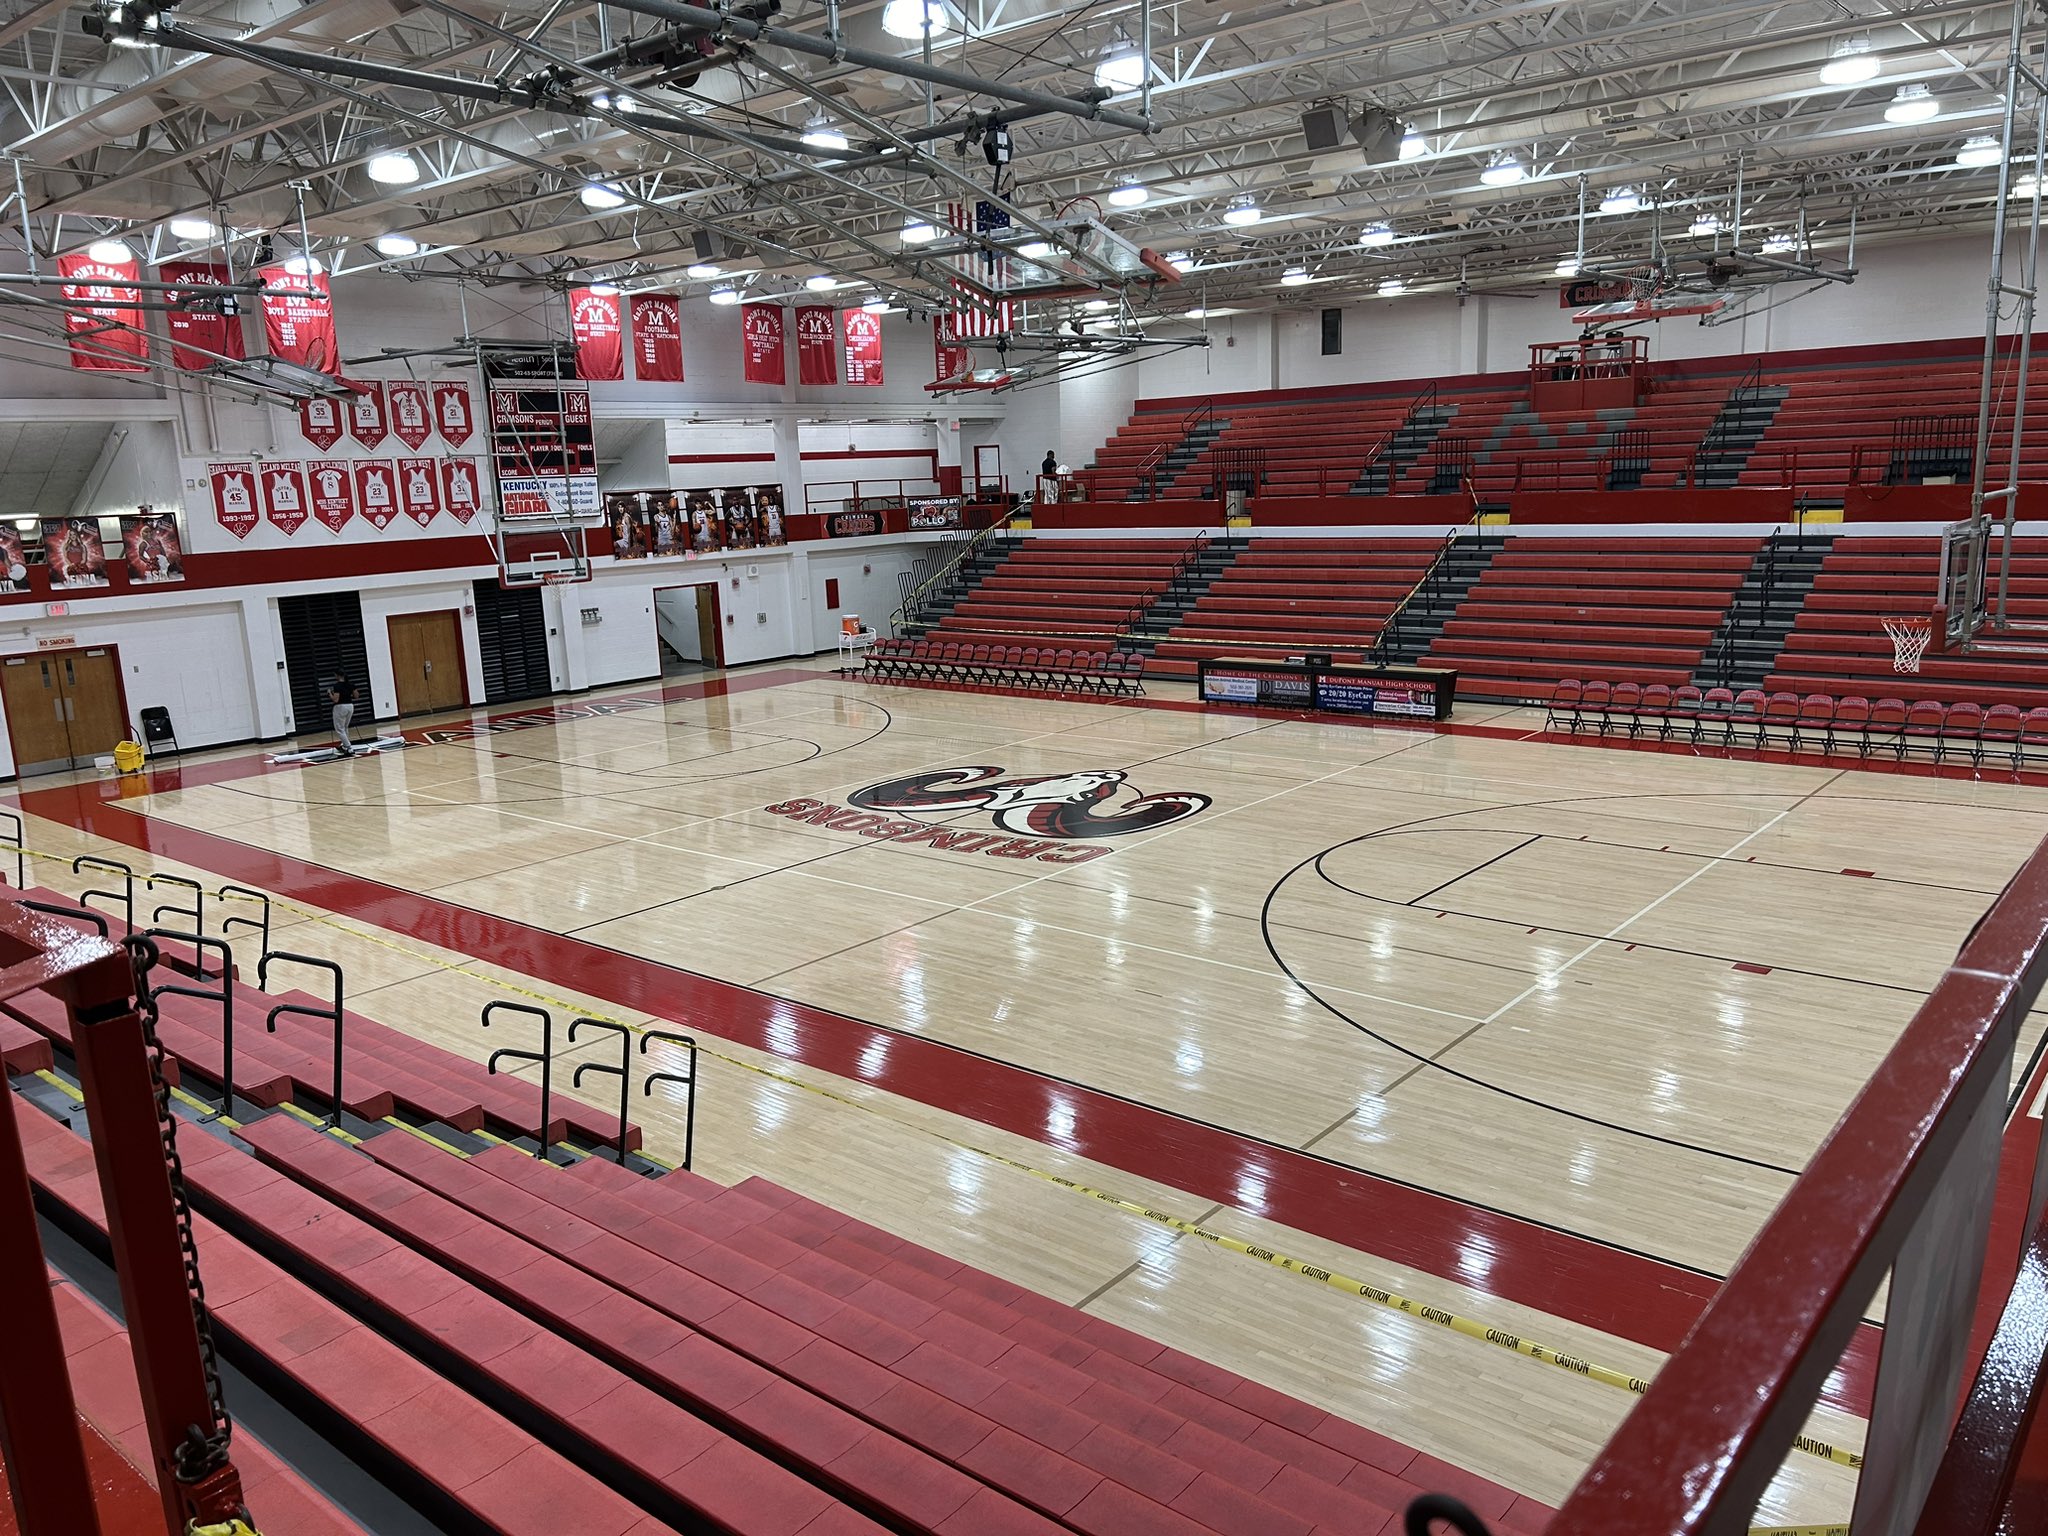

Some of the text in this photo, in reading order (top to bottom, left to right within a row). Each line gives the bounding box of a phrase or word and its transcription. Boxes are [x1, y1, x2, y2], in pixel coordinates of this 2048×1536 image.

[587, 308, 604, 323] M
[648, 311, 664, 326] M
[654, 300, 678, 323] MANUAL
[756, 320, 770, 334] M
[809, 320, 822, 333] M
[856, 322, 869, 336] M
[752, 341, 774, 349] SOFTBALL
[496, 393, 588, 412] M M
[315, 408, 326, 416] 55
[496, 414, 534, 424] CRIMSONS
[564, 414, 588, 424] GUEST
[230, 493, 242, 501] 45
[280, 492, 289, 500] 11
[372, 488, 382, 496] 23
[416, 486, 424, 494] 23
[503, 492, 538, 502] NATIONAL
[834, 516, 876, 535] CRAZIES
[64, 573, 98, 586] JENNA
[39, 637, 75, 647] NO SMOKING
[1275, 680, 1310, 690] DAVIS
[1319, 675, 1326, 683] M
[1357, 679, 1384, 687] MANUAL
[1385, 680, 1404, 688] HIGH
[1405, 682, 1432, 690] SCHOOL
[1328, 689, 1372, 700] 20/20 EyeCare
[764, 798, 1114, 864] CRIMSONS
[1052, 1176, 1076, 1188] CAUTION
[1097, 1192, 1120, 1206] CAUTION
[1144, 1209, 1170, 1224] CAUTION
[1194, 1227, 1220, 1242] CAUTION
[1246, 1245, 1275, 1262] CAUTION
[1302, 1264, 1332, 1282] CAUTION
[1360, 1286, 1391, 1304] CAUTION
[1420, 1306, 1454, 1327] CAUTION
[1486, 1328, 1520, 1350] CAUTION
[1554, 1352, 1590, 1375] CAUTION
